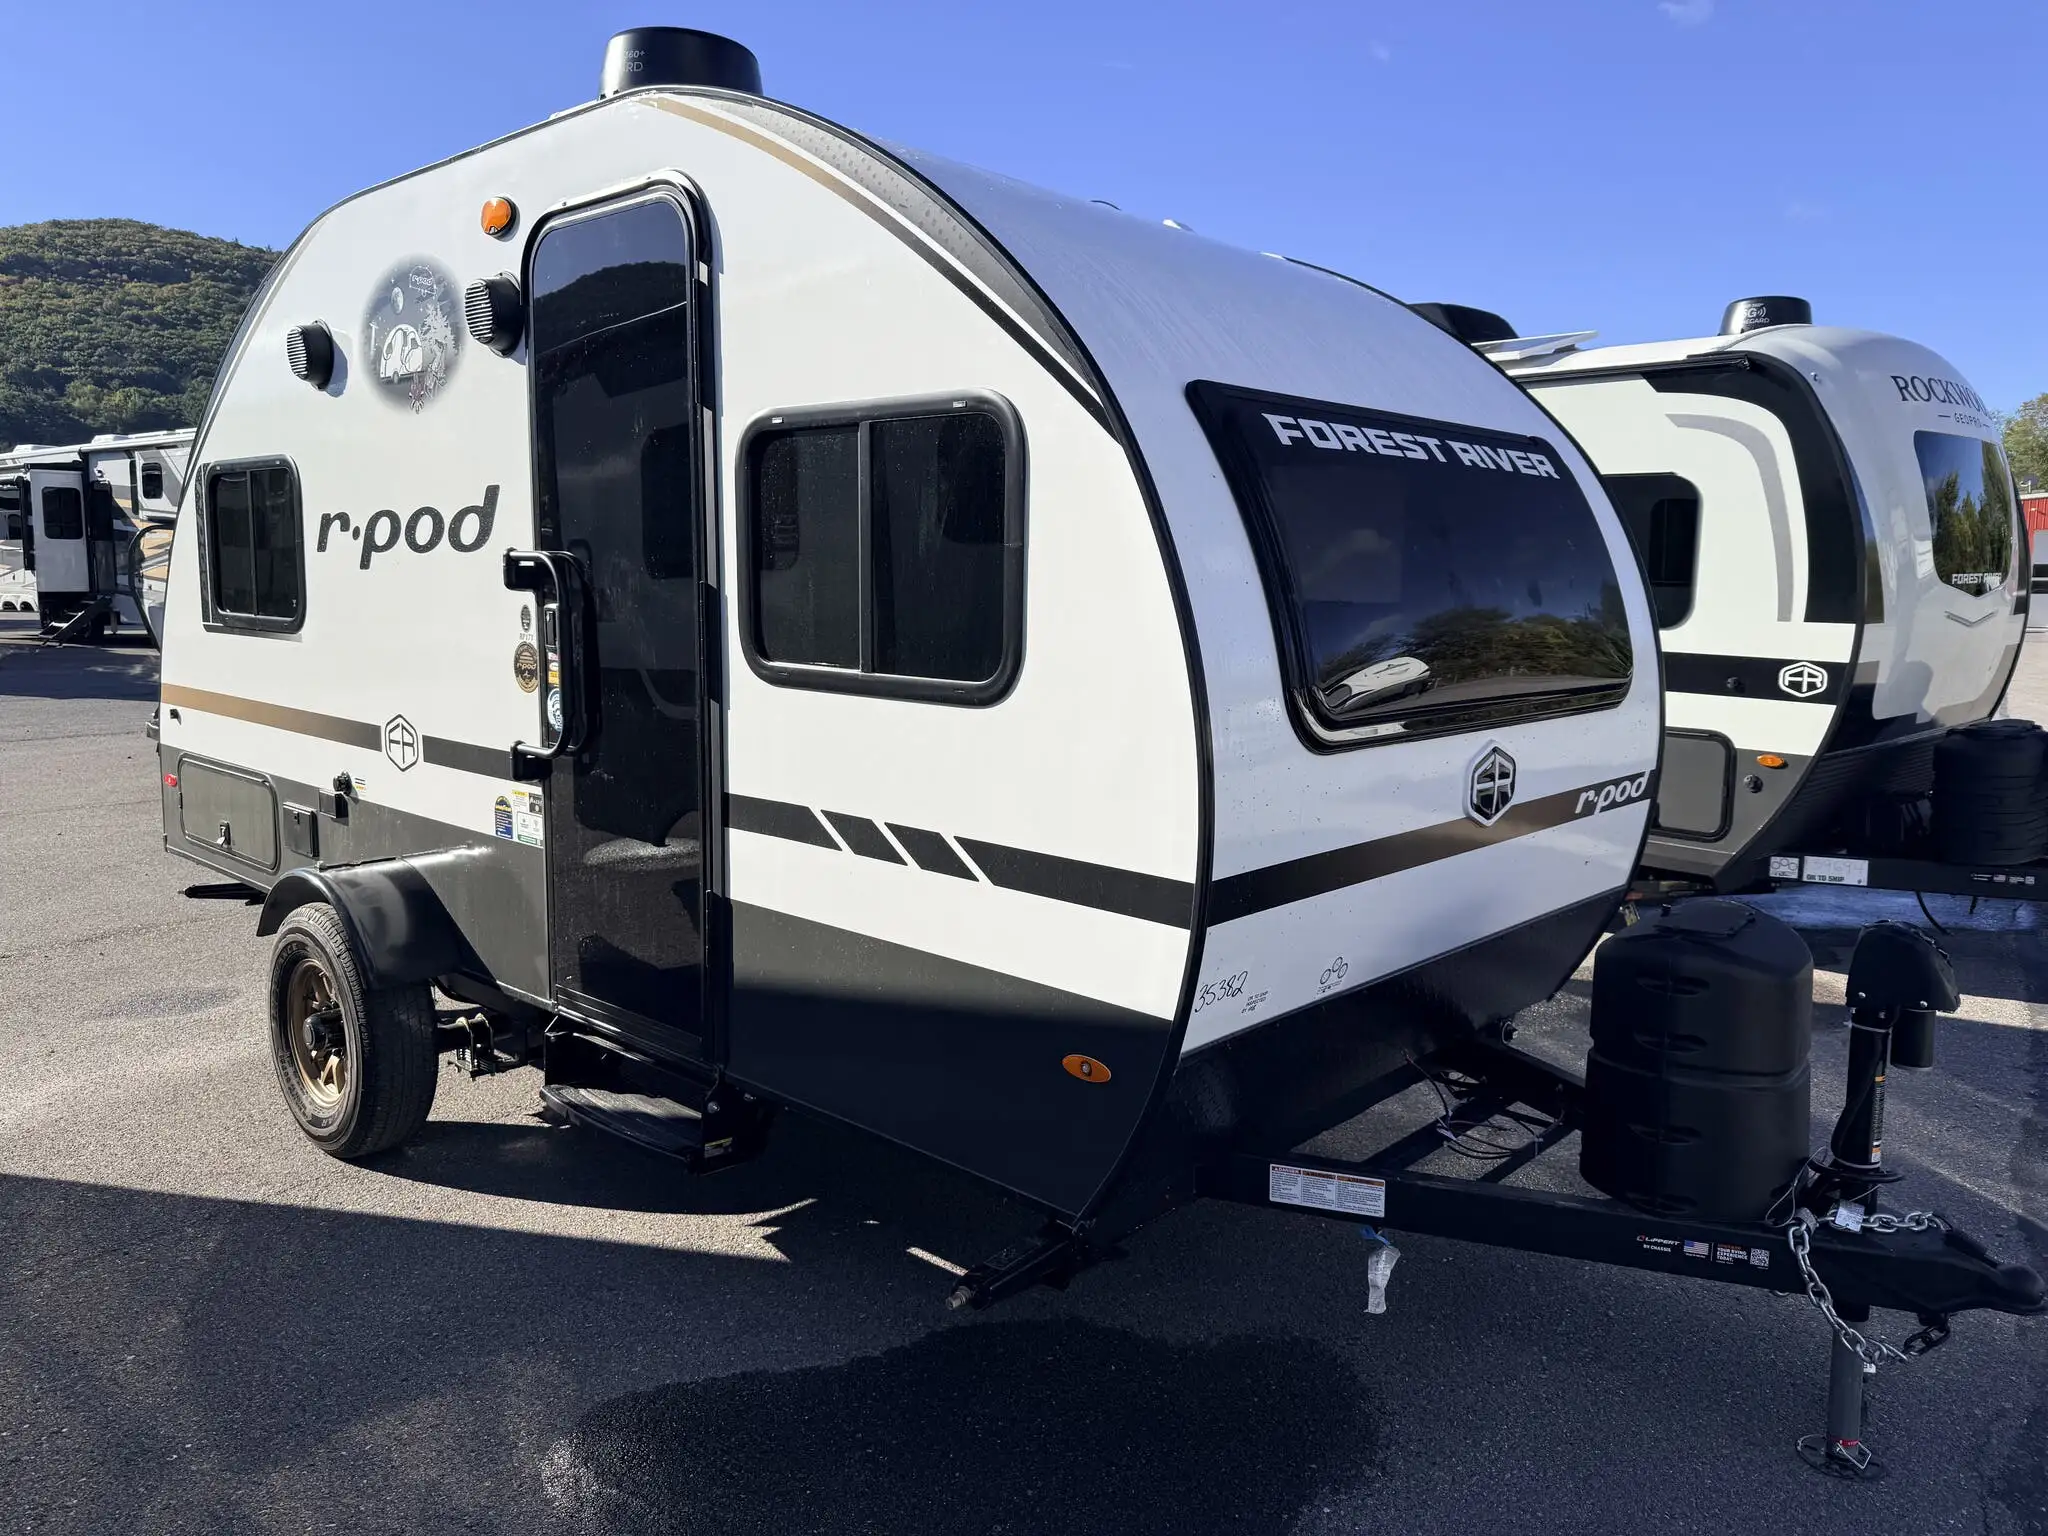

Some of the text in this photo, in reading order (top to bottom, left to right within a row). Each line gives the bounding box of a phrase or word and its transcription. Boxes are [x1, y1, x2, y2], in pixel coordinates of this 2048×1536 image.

[1261, 412, 1560, 480] FOREST RIVER
[1951, 573, 1983, 585] FOREST
[1195, 970, 1249, 1013] 35382
[1645, 1237, 1680, 1246] LIPPERT
